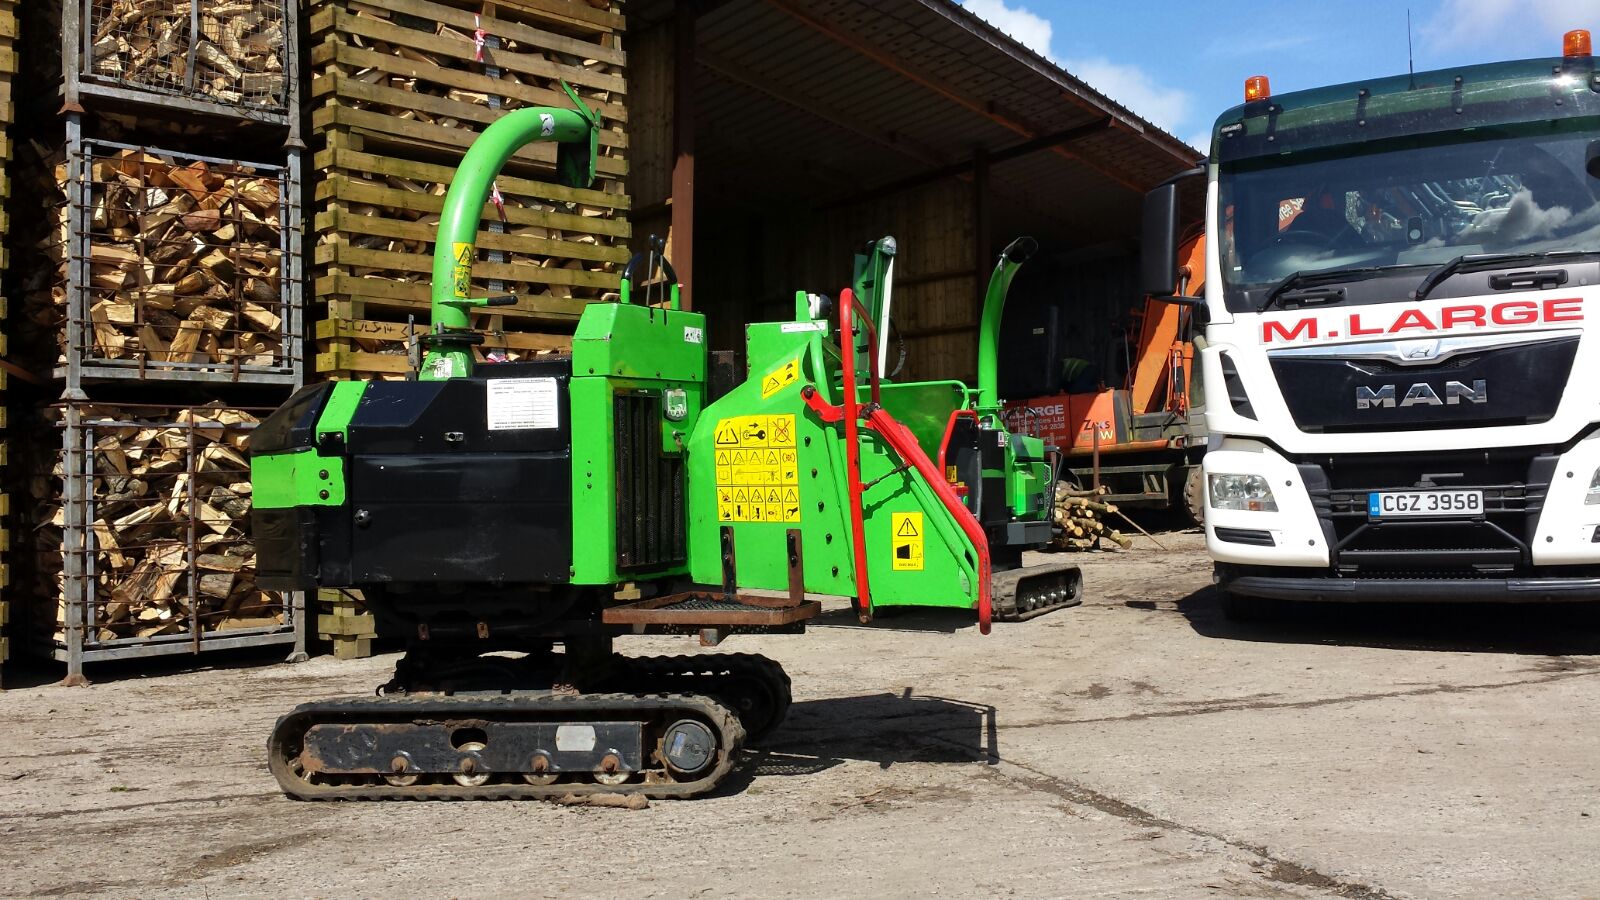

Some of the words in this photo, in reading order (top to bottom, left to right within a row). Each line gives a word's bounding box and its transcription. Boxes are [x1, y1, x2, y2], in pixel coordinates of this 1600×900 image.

[1356, 379, 1488, 409] MAN
[1053, 415, 1065, 423] Ltd
[1383, 494, 1421, 512] CGZ
[1427, 493, 1479, 511] 3958
